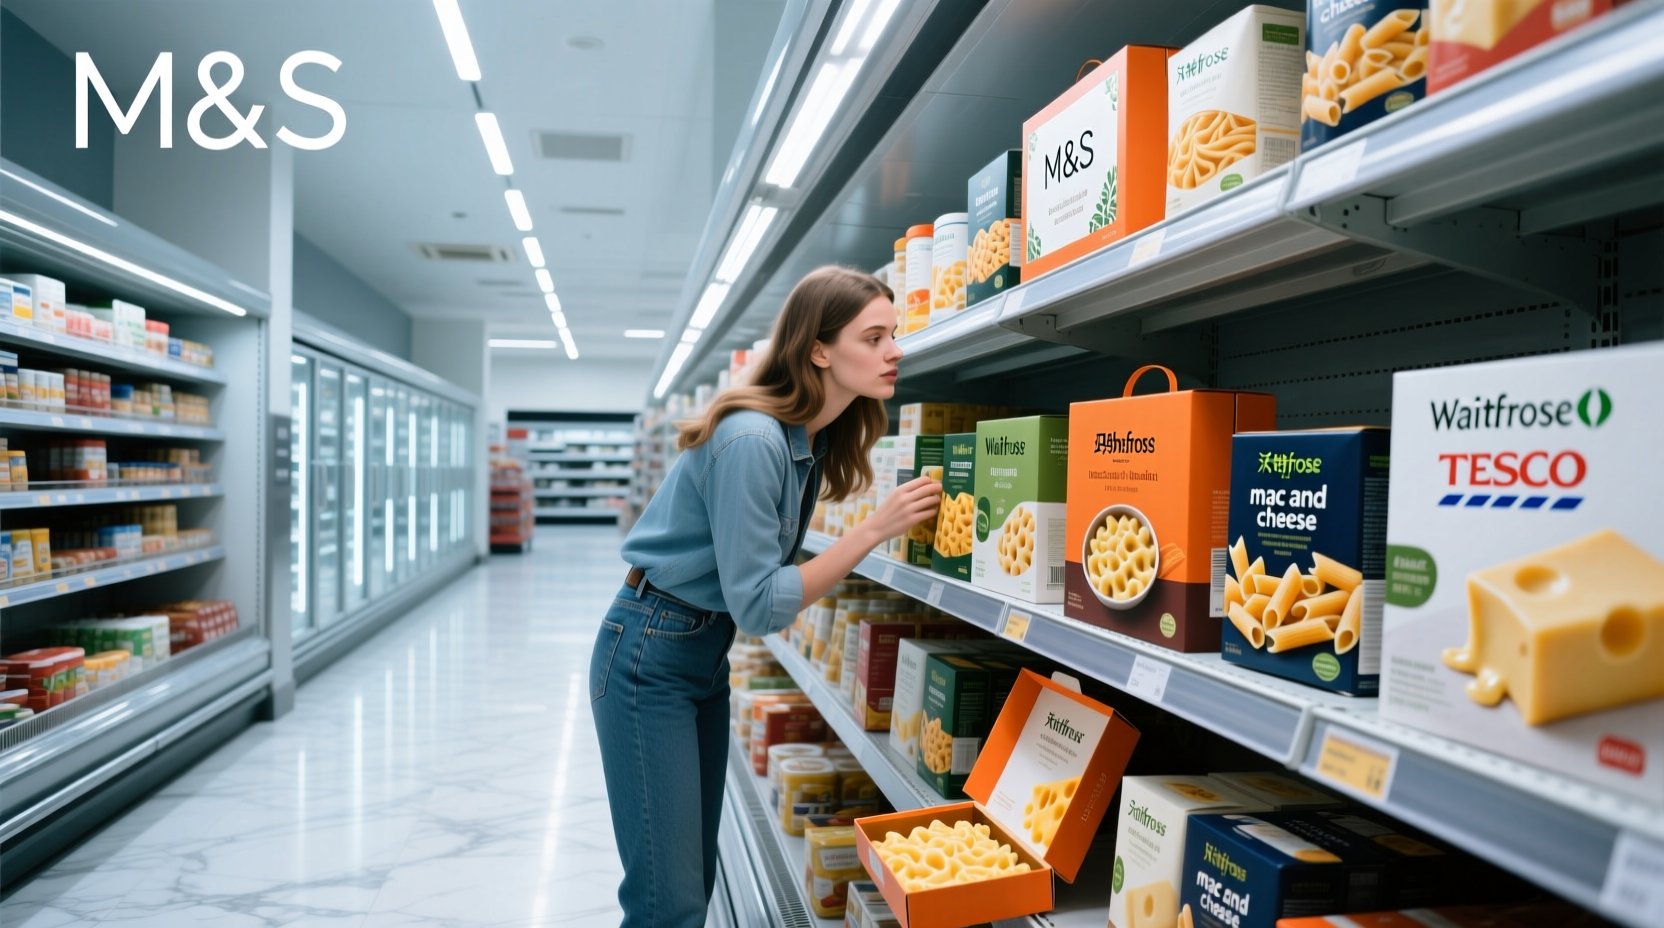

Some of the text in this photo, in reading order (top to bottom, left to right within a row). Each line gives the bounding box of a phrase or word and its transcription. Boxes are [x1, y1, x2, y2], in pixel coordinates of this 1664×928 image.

[1045, 130, 1094, 190] M&S
[1430, 393, 1573, 431] Waitfrose
[1438, 451, 1587, 488] TESCO
[1250, 484, 1327, 509] mac and
[1256, 506, 1317, 531] cheese
[1196, 871, 1250, 916] mac and
